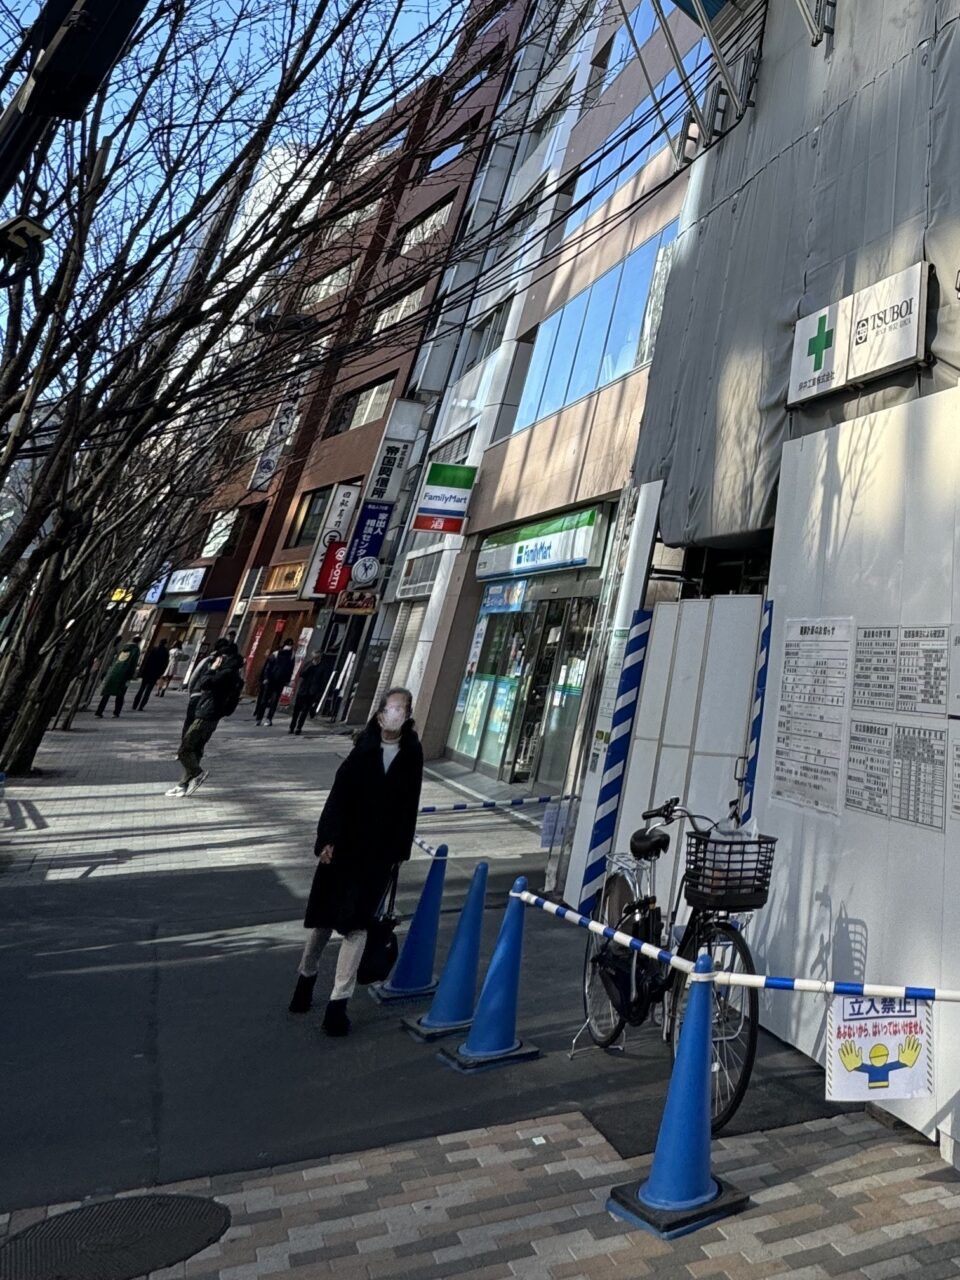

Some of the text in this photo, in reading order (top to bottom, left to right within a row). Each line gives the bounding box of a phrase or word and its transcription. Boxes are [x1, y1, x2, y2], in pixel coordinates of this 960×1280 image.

[870, 297, 914, 330] TSUBOI
[424, 493, 467, 504] FamilyMart
[431, 518, 444, 530] 酒
[524, 541, 552, 563] FamilyMart
[849, 997, 912, 1016] 立入禁止
